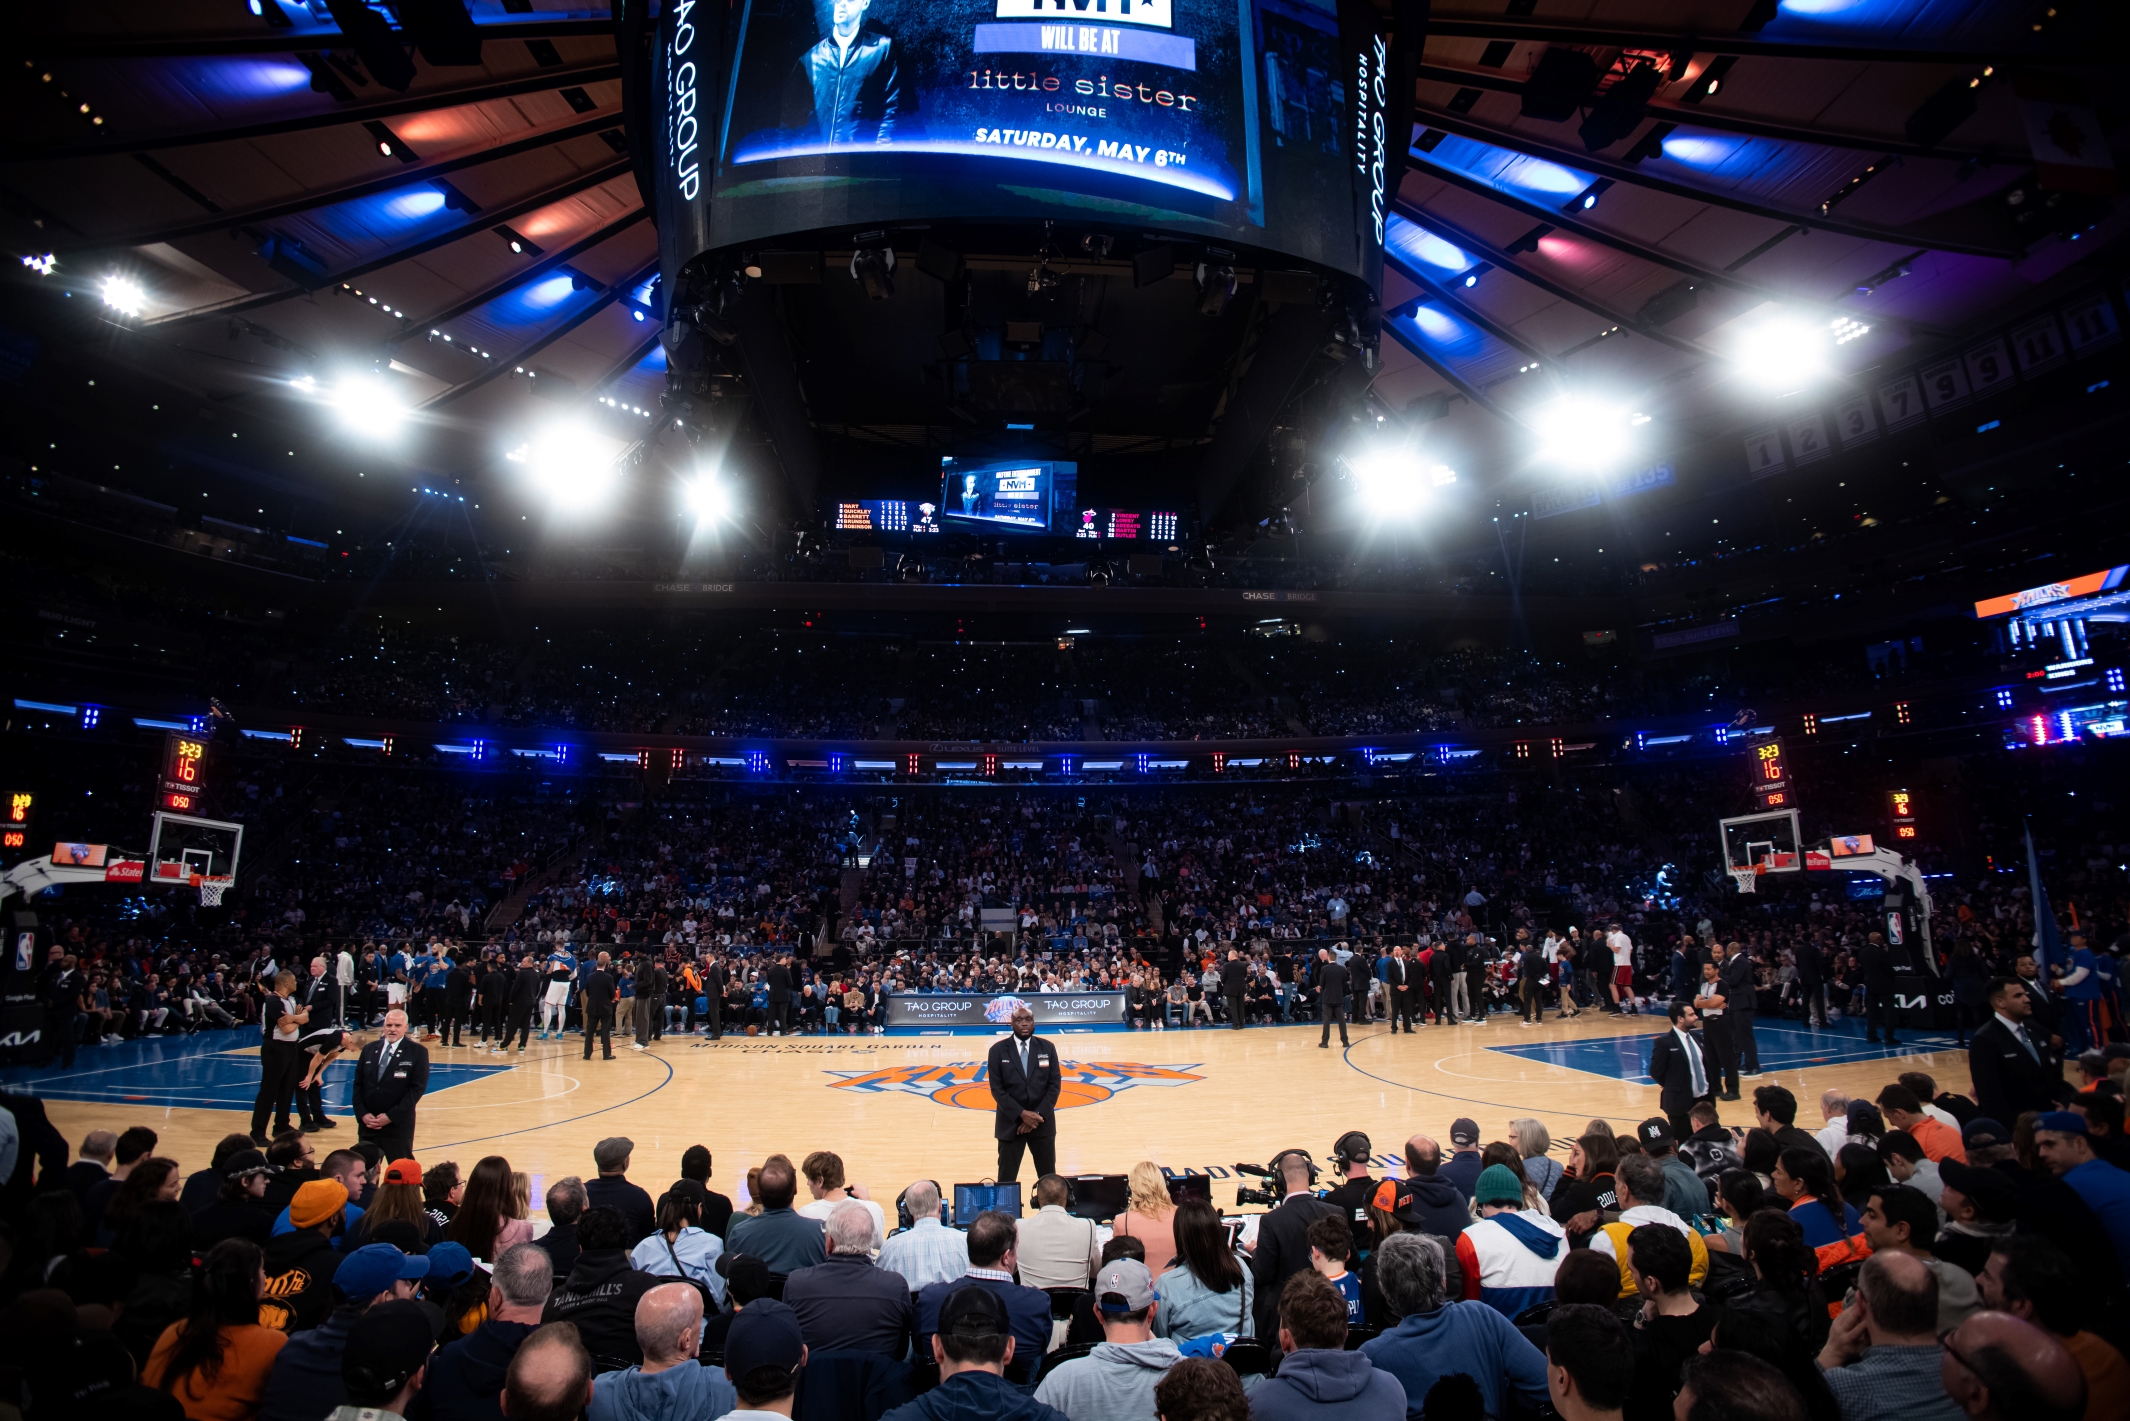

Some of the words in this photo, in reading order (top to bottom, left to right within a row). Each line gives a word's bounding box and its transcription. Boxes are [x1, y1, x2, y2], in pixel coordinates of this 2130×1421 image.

[1041, 26, 1075, 50] WILL
[1079, 28, 1097, 52] BE
[1101, 30, 1120, 54] AT
[1373, 34, 1386, 107] TAO
[968, 69, 1060, 91] little
[1074, 75, 1197, 111] sister
[1046, 103, 1107, 118] LOUNGE
[1357, 53, 1368, 175] HOSPITALITY
[675, 61, 699, 201] GROUP
[975, 127, 1092, 156] SATURDAY,
[1097, 139, 1150, 166] MAY
[1154, 150, 1187, 168] 6TH
[1371, 111, 1386, 246] GROUP
[2076, 309, 2109, 344] 11
[2023, 331, 2056, 365] 11
[1979, 356, 1999, 383] 9
[1937, 374, 1956, 401] 9
[1892, 392, 1908, 418] 7
[1849, 410, 1865, 434] 3
[1802, 427, 1817, 451] 2
[1758, 443, 1772, 466] 1
[1006, 480, 1026, 489] NVM
[921, 516, 932, 524] 47
[655, 584, 690, 592] CHASE
[702, 584, 733, 592] BRIDGE
[1242, 592, 1275, 600] CHASE
[2011, 582, 2071, 609] KNICKS
[38, 609, 63, 621] BUD
[64, 615, 98, 628] LIGHT
[1711, 625, 1736, 636] LEVEL
[2046, 658, 2094, 671] WARRIORS
[2026, 670, 2045, 679] 2:00
[2047, 669, 2076, 679] KINGS
[179, 741, 202, 758] 3:23
[1758, 744, 1780, 760] 3:23
[178, 758, 195, 781] 16
[1764, 758, 1780, 779] 16
[175, 783, 200, 793] TISSOT
[1764, 782, 1786, 790] TISSOT
[173, 795, 189, 808] 0:50
[1768, 794, 1784, 805] 0:50
[13, 807, 25, 821] 16
[1898, 803, 1908, 815] 16
[5, 833, 24, 846] 0:50
[1900, 827, 1915, 837] 0:50
[904, 1002, 929, 1011] TAO
[932, 1001, 972, 1011] GROUP
[1044, 1000, 1069, 1010] TAO
[1071, 999, 1110, 1009] GROUP
